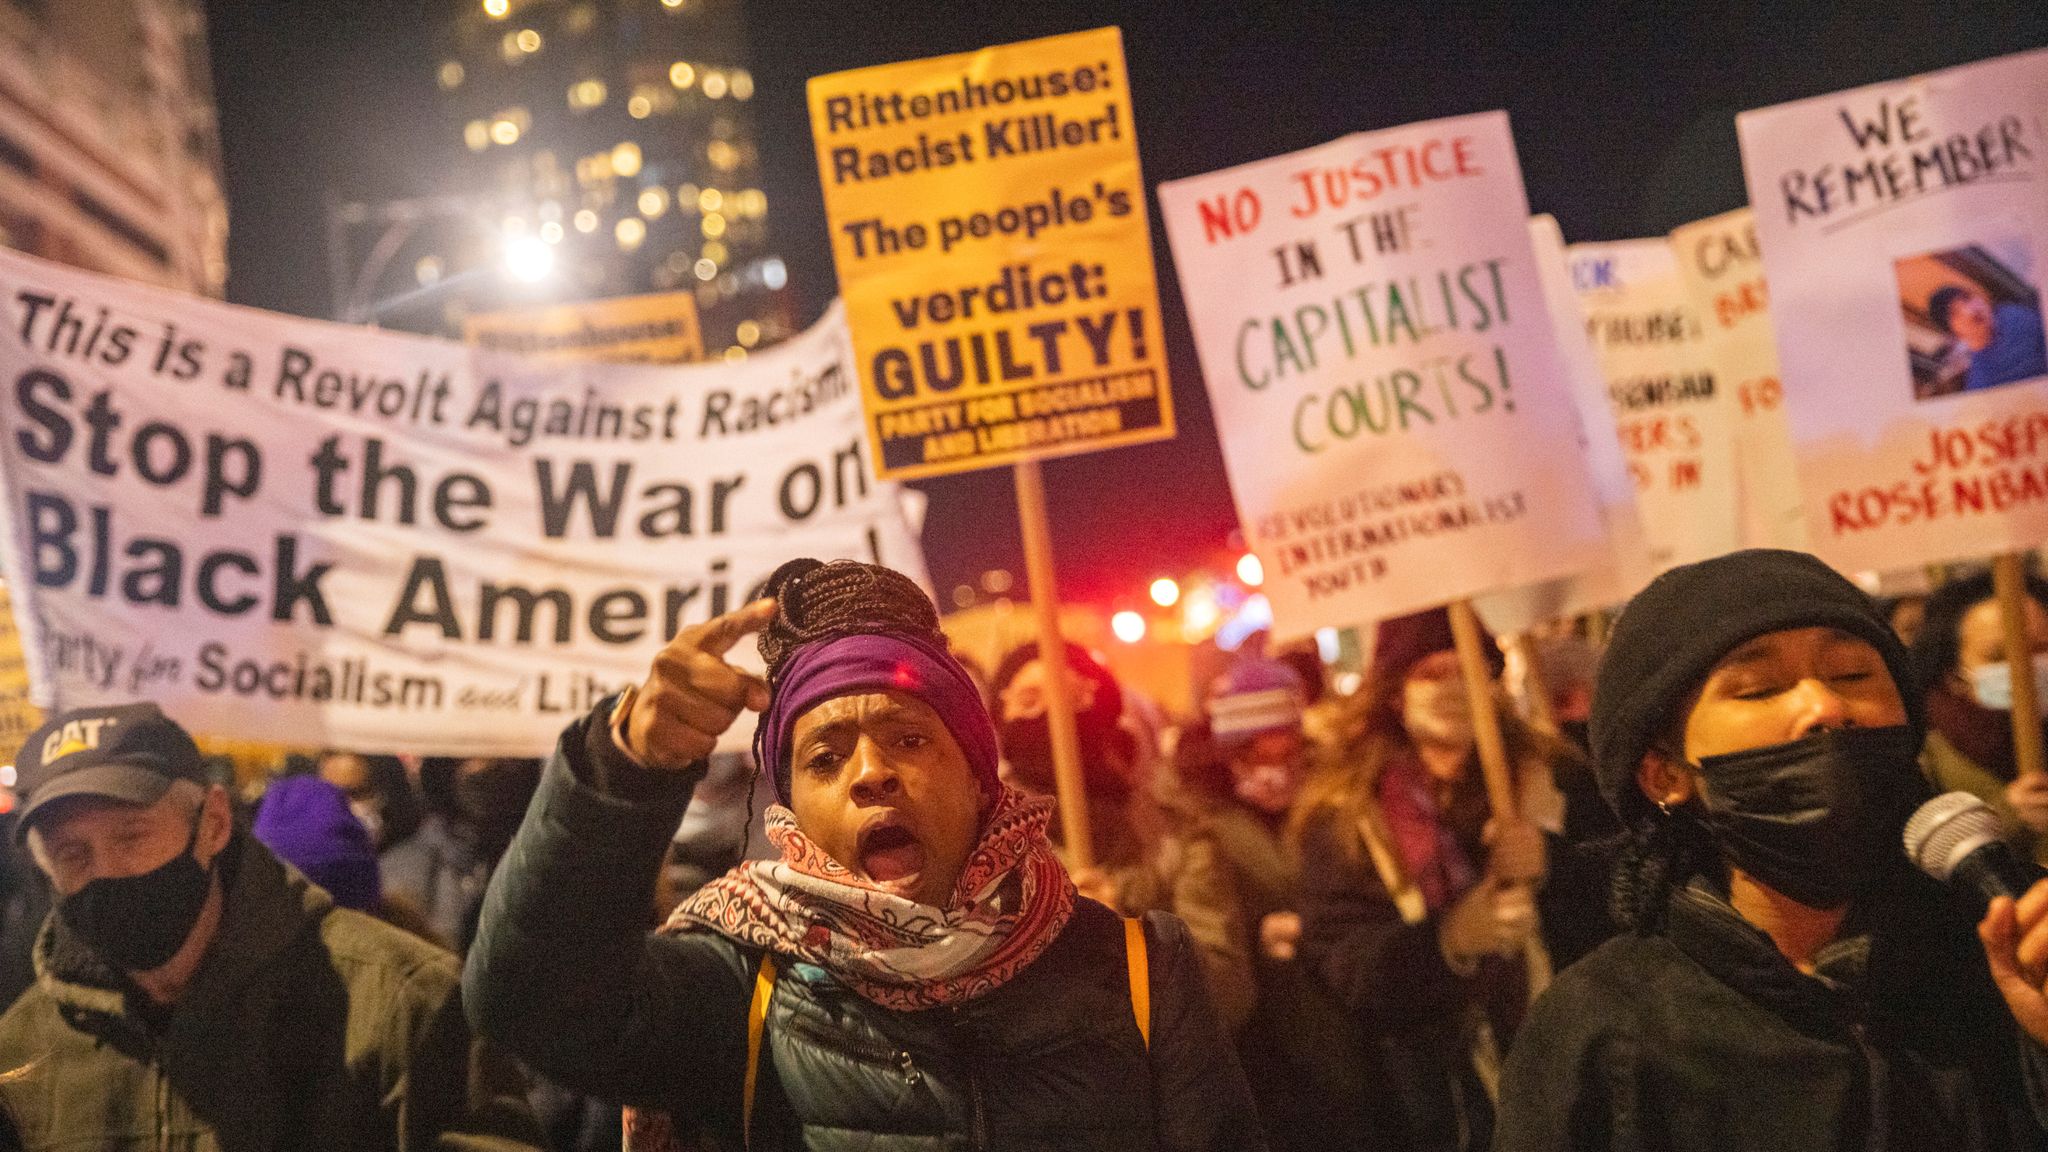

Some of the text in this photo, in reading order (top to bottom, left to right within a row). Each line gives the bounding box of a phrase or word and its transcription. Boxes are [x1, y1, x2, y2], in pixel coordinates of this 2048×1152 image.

[825, 60, 1112, 134] Rittenhouse:
[1838, 96, 1930, 150] WE
[832, 103, 1121, 184] Racist Killer!
[1780, 113, 2032, 226] REMEMBER
[844, 183, 1131, 258] The people's
[1198, 135, 1485, 245] NO JUSTICE
[893, 264, 1109, 329] verdict:
[1272, 240, 1322, 289] IN
[871, 308, 1148, 401] GUILTY!
[1234, 256, 1514, 392] CAPITALIST
[17, 292, 137, 366] This
[153, 323, 206, 379] is
[223, 350, 252, 392] a
[276, 348, 452, 426] Revolt
[468, 382, 680, 446] Against
[881, 406, 962, 438] PARTY
[1018, 372, 1155, 414] SOCIALISM
[1292, 346, 1516, 455] COURTS!
[15, 369, 869, 540] Stop the War on
[1829, 462, 2048, 536] ROSENBA
[26, 492, 772, 646] Black Ameri
[198, 640, 442, 709] Socialism
[41, 717, 106, 766] CAT
